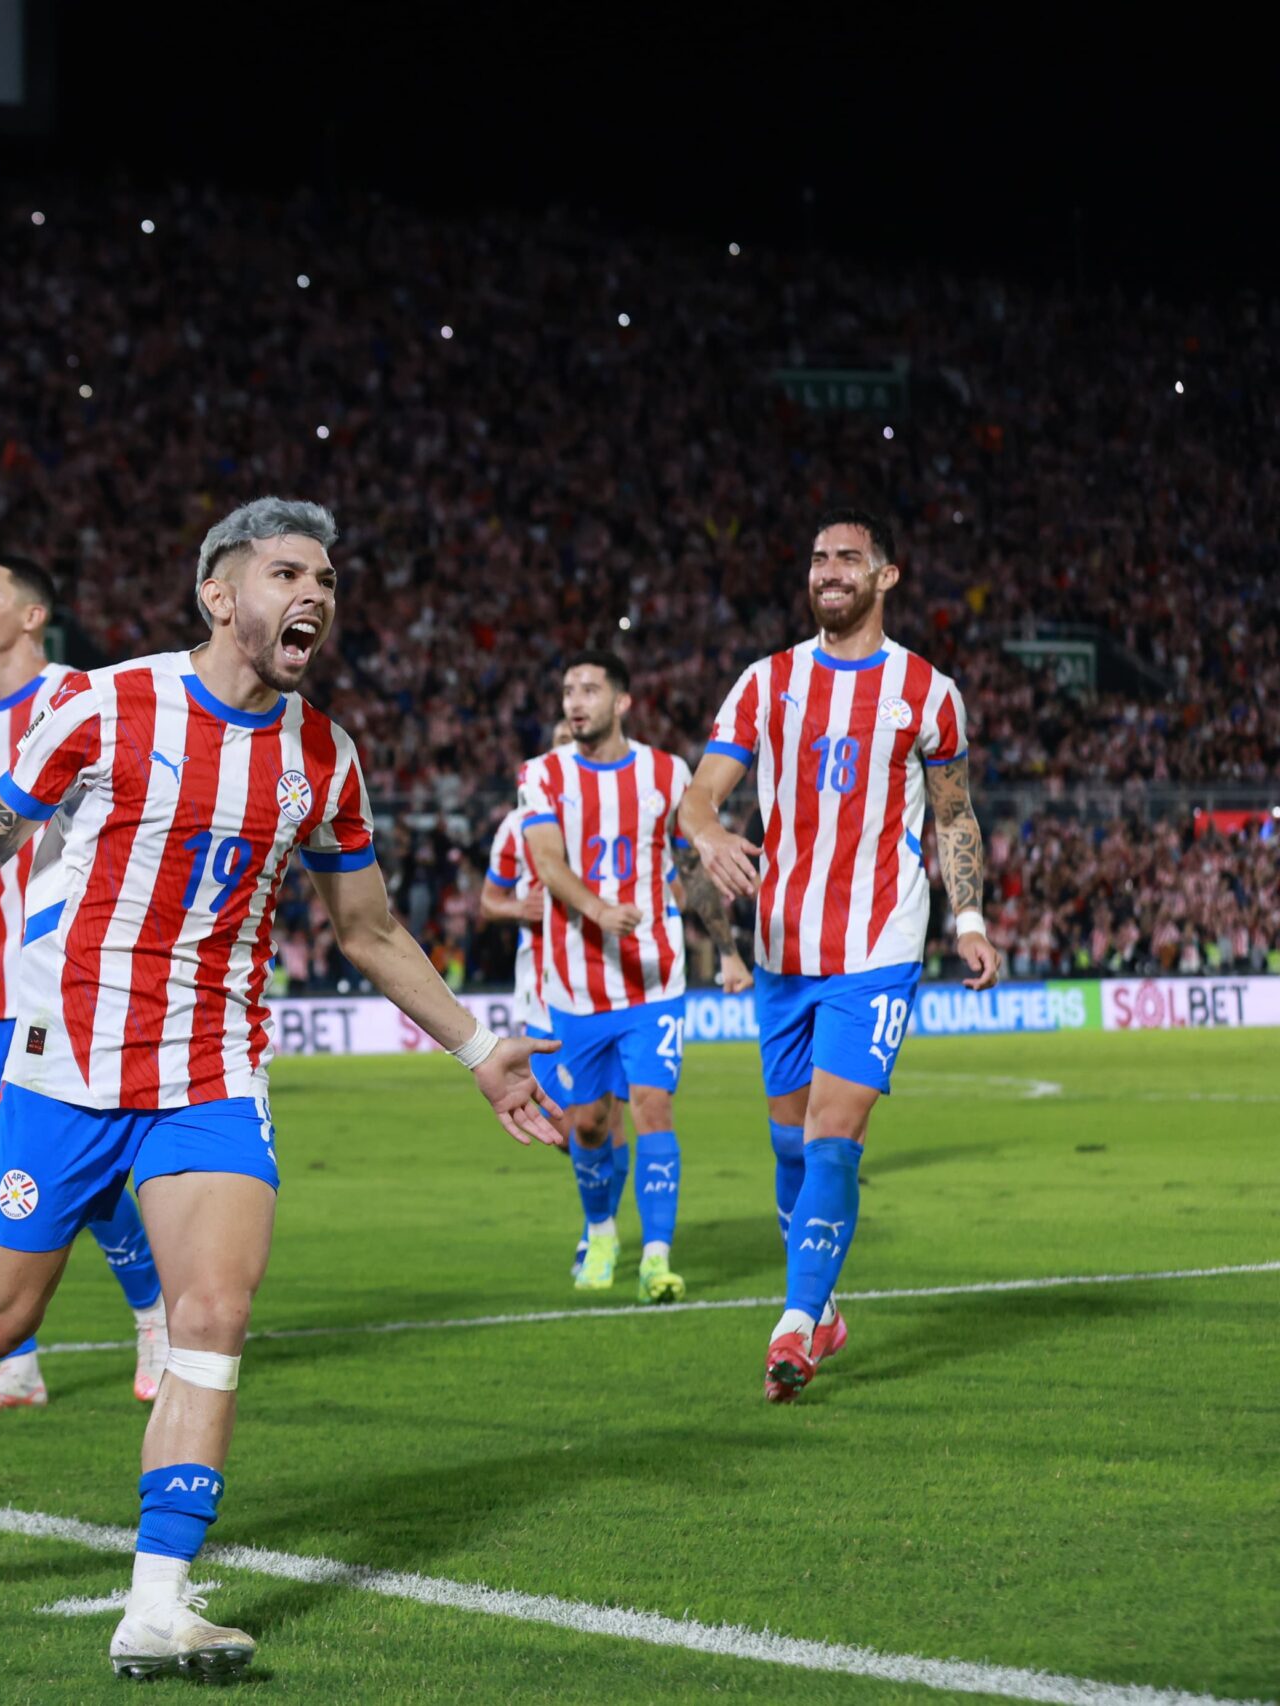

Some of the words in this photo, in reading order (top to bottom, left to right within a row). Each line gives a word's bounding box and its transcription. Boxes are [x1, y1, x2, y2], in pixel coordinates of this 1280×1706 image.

[810, 735, 860, 794] 18
[183, 831, 252, 914] 19
[588, 834, 633, 881] 20
[684, 997, 760, 1039] ORL
[921, 988, 1085, 1032] QUALIFIERS
[870, 993, 908, 1049] 18
[1113, 978, 1248, 1028] SOLBET
[280, 1008, 357, 1054] BET
